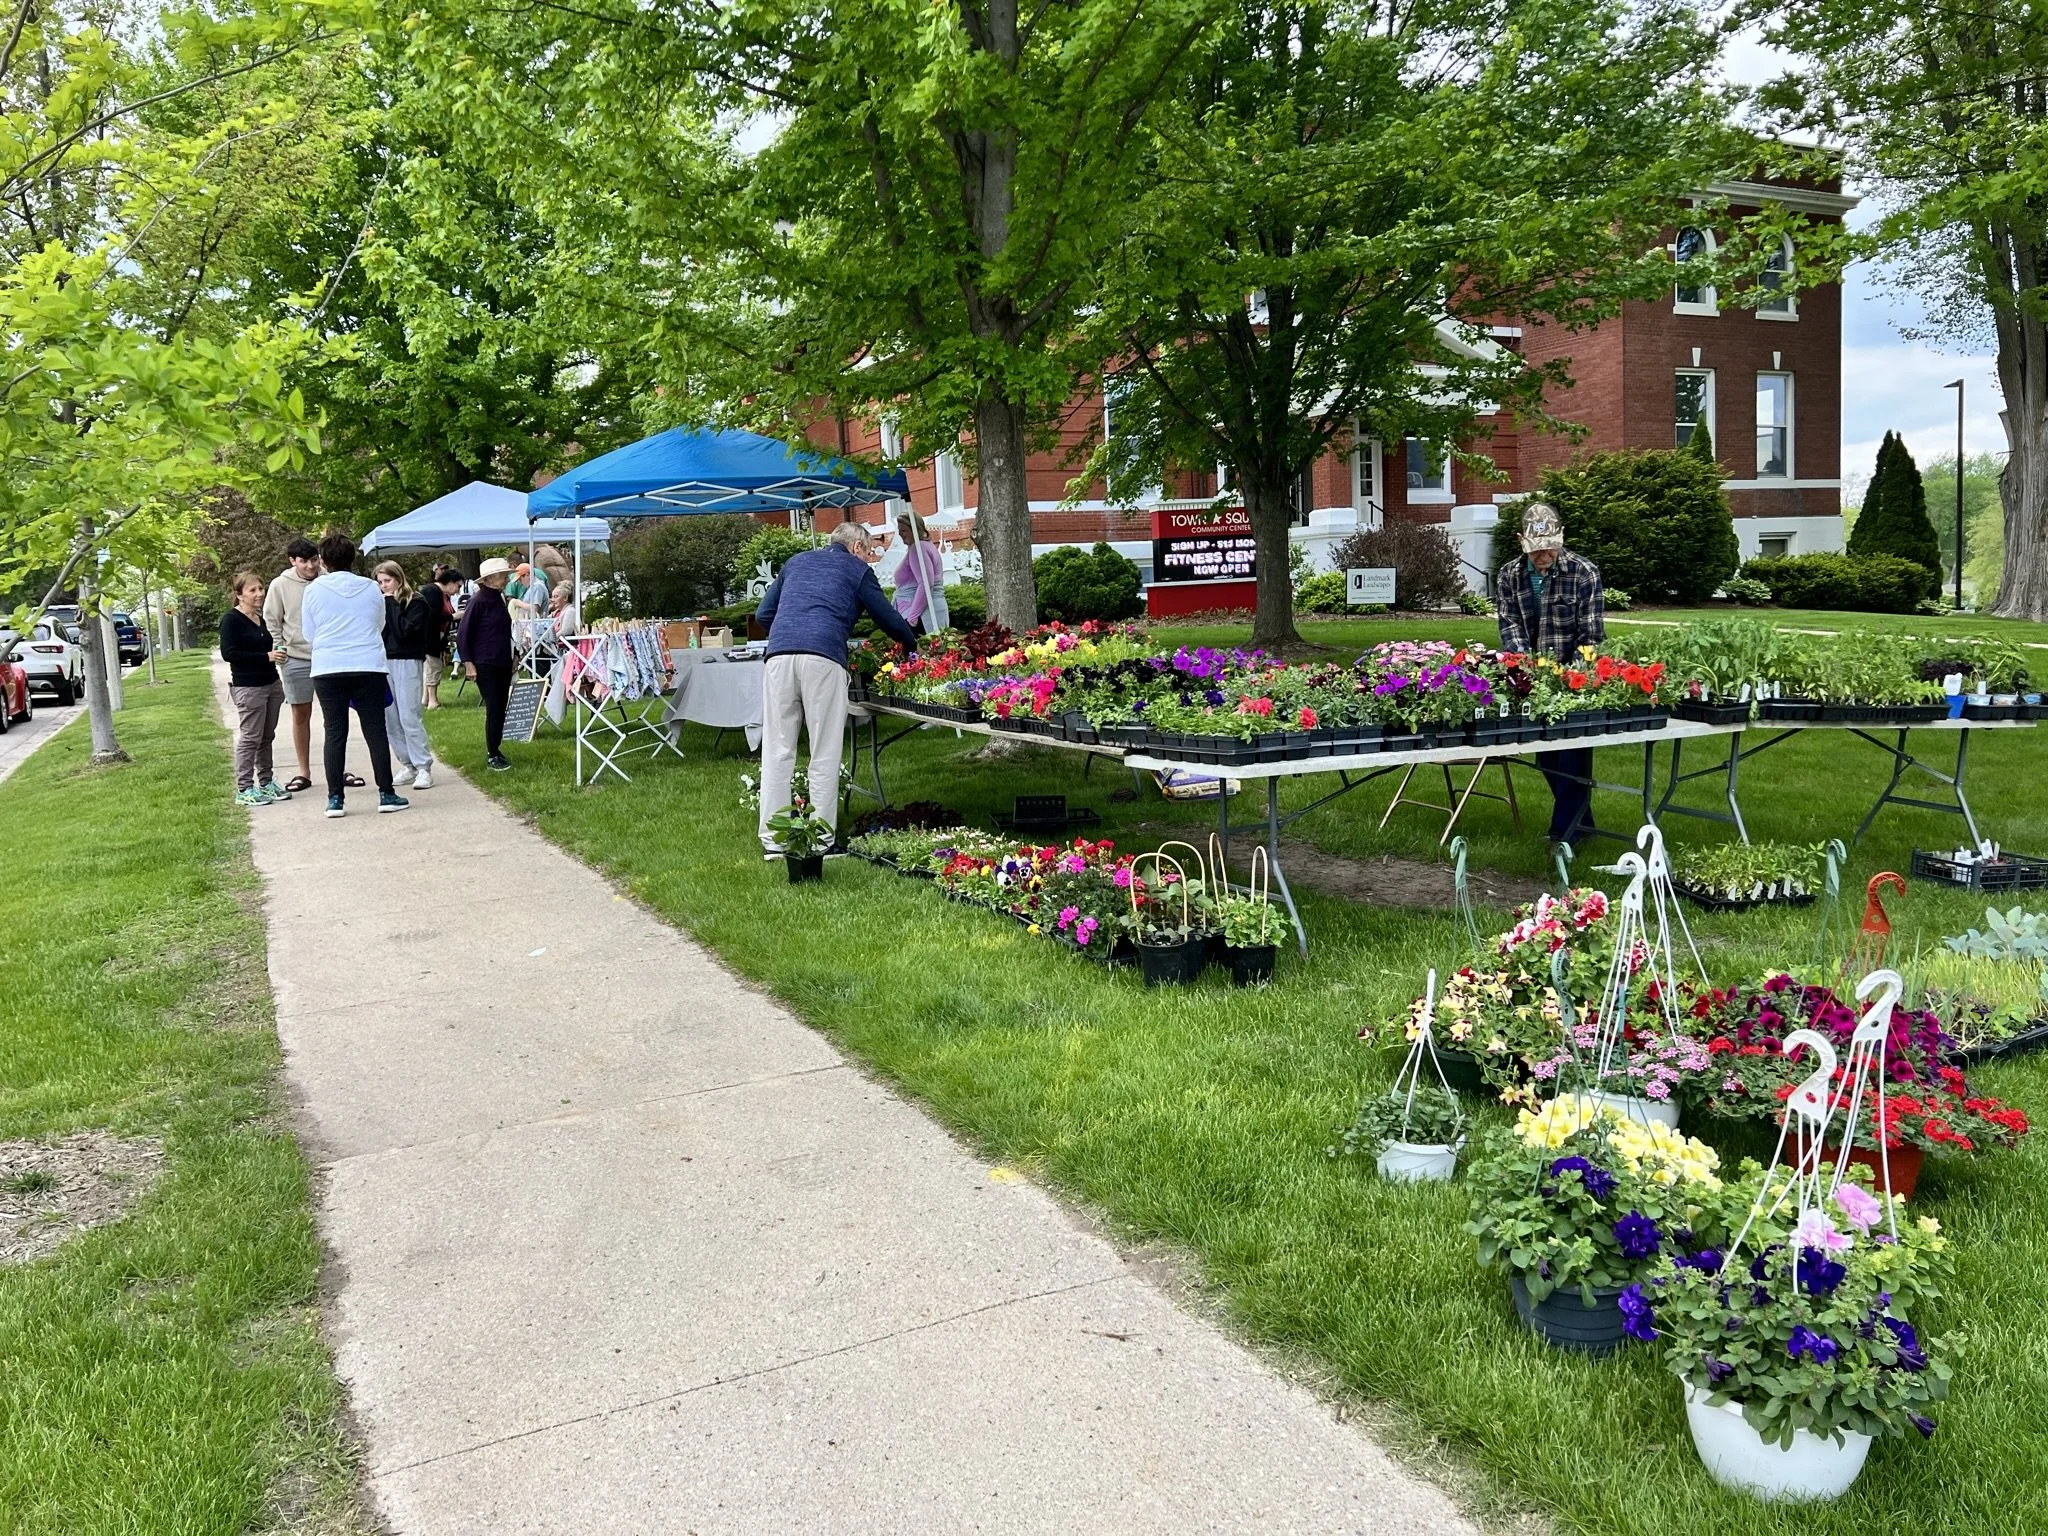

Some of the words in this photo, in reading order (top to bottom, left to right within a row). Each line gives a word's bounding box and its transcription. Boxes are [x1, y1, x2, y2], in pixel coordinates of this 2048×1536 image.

[1191, 526, 1228, 534] COMMUNITY
[1171, 542, 1195, 551] SIGN
[1196, 540, 1210, 549] UP
[1164, 552, 1223, 566] FITNESS
[1193, 564, 1219, 575] NOW
[1220, 563, 1250, 573] OPEN
